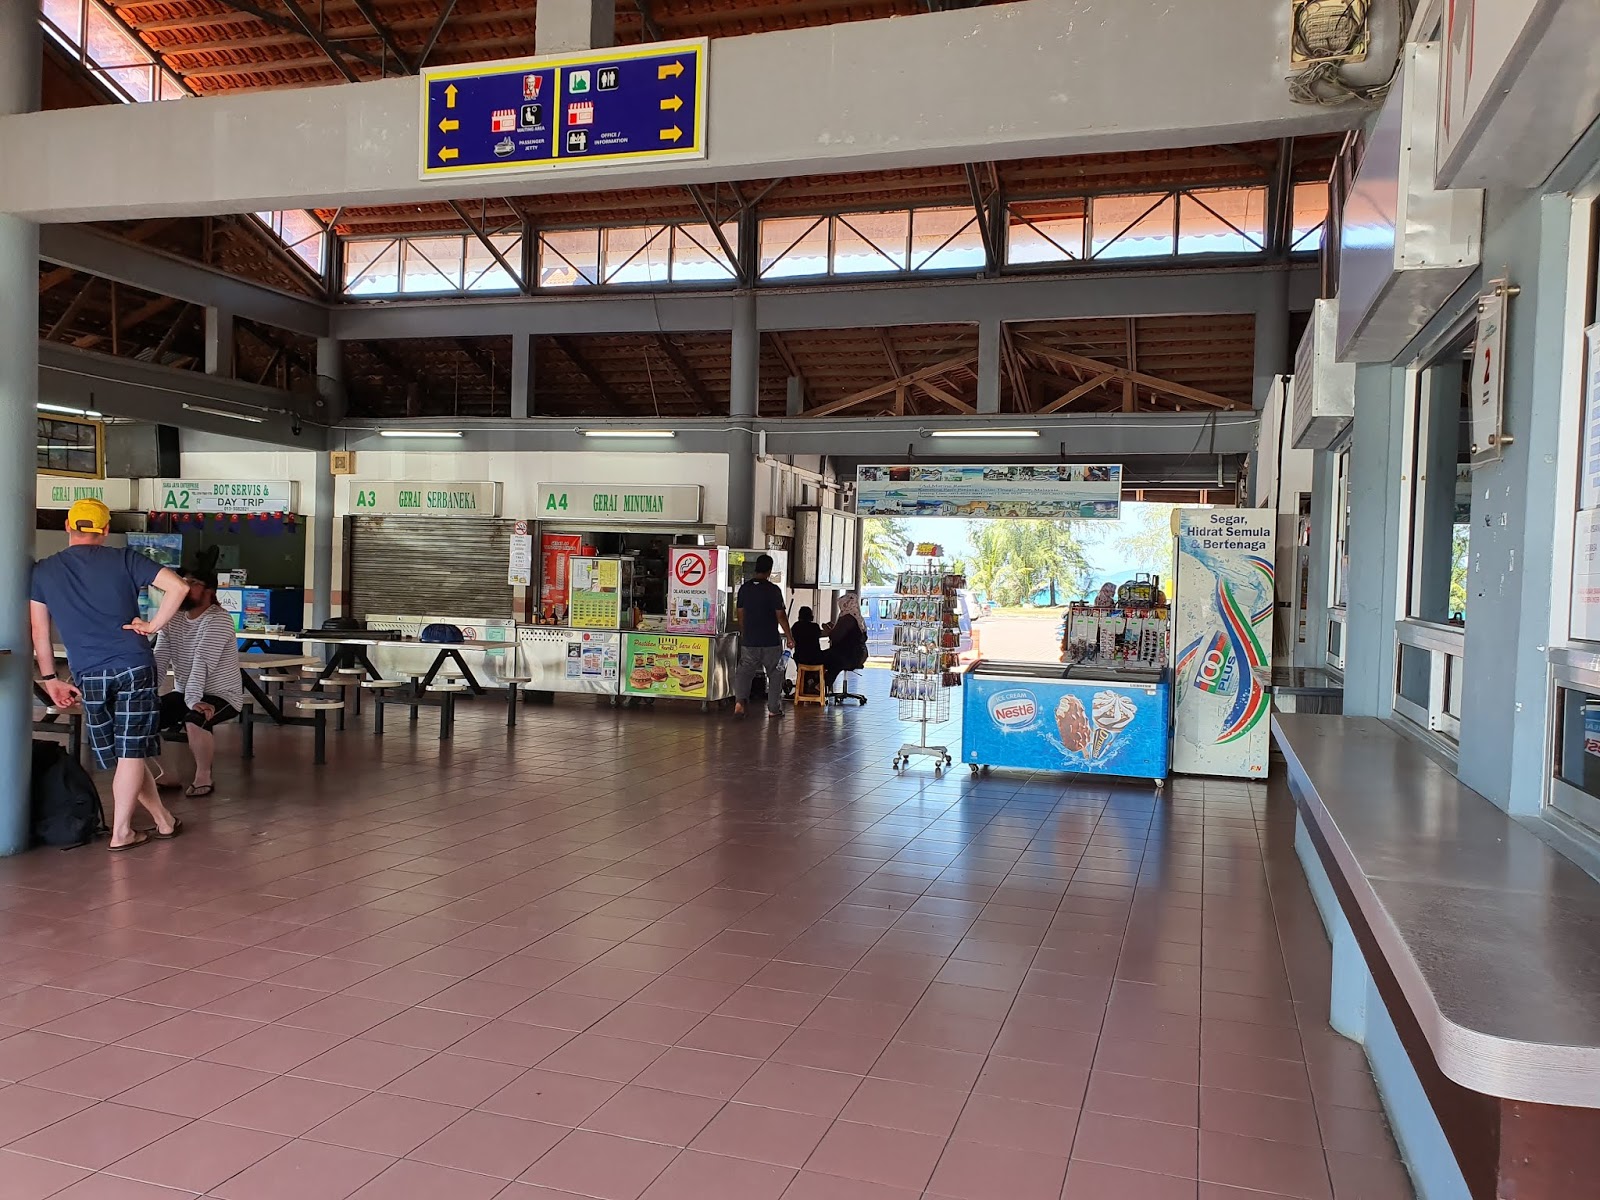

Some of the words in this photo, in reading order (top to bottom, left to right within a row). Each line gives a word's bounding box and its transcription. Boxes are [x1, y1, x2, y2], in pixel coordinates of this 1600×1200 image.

[1484, 348, 1491, 384] 2
[52, 486, 70, 501] GERAI
[73, 487, 104, 501] MINUMAN
[213, 484, 230, 496] BOT
[231, 484, 261, 496] SERVIS
[263, 485, 269, 496] &
[164, 490, 190, 509] A2
[217, 498, 237, 506] DAY
[242, 498, 265, 506] TRIP
[356, 490, 376, 507] A3
[398, 490, 421, 508] GERAI
[427, 491, 476, 509] SERBANEKA
[546, 493, 568, 511] A4
[593, 493, 618, 512] GERAI
[623, 494, 663, 513] MINUMAN
[1210, 514, 1248, 525] Segar,
[1187, 527, 1223, 536] Hidrat
[1226, 527, 1270, 536] Semula
[1191, 540, 1200, 549] &
[1203, 540, 1266, 551] Bertenaga
[634, 639, 656, 647] Pastikan
[1196, 650, 1225, 686] 100
[1218, 656, 1236, 691] PLUS
[996, 694, 1005, 702] ICE
[1005, 692, 1027, 700] CREAM
